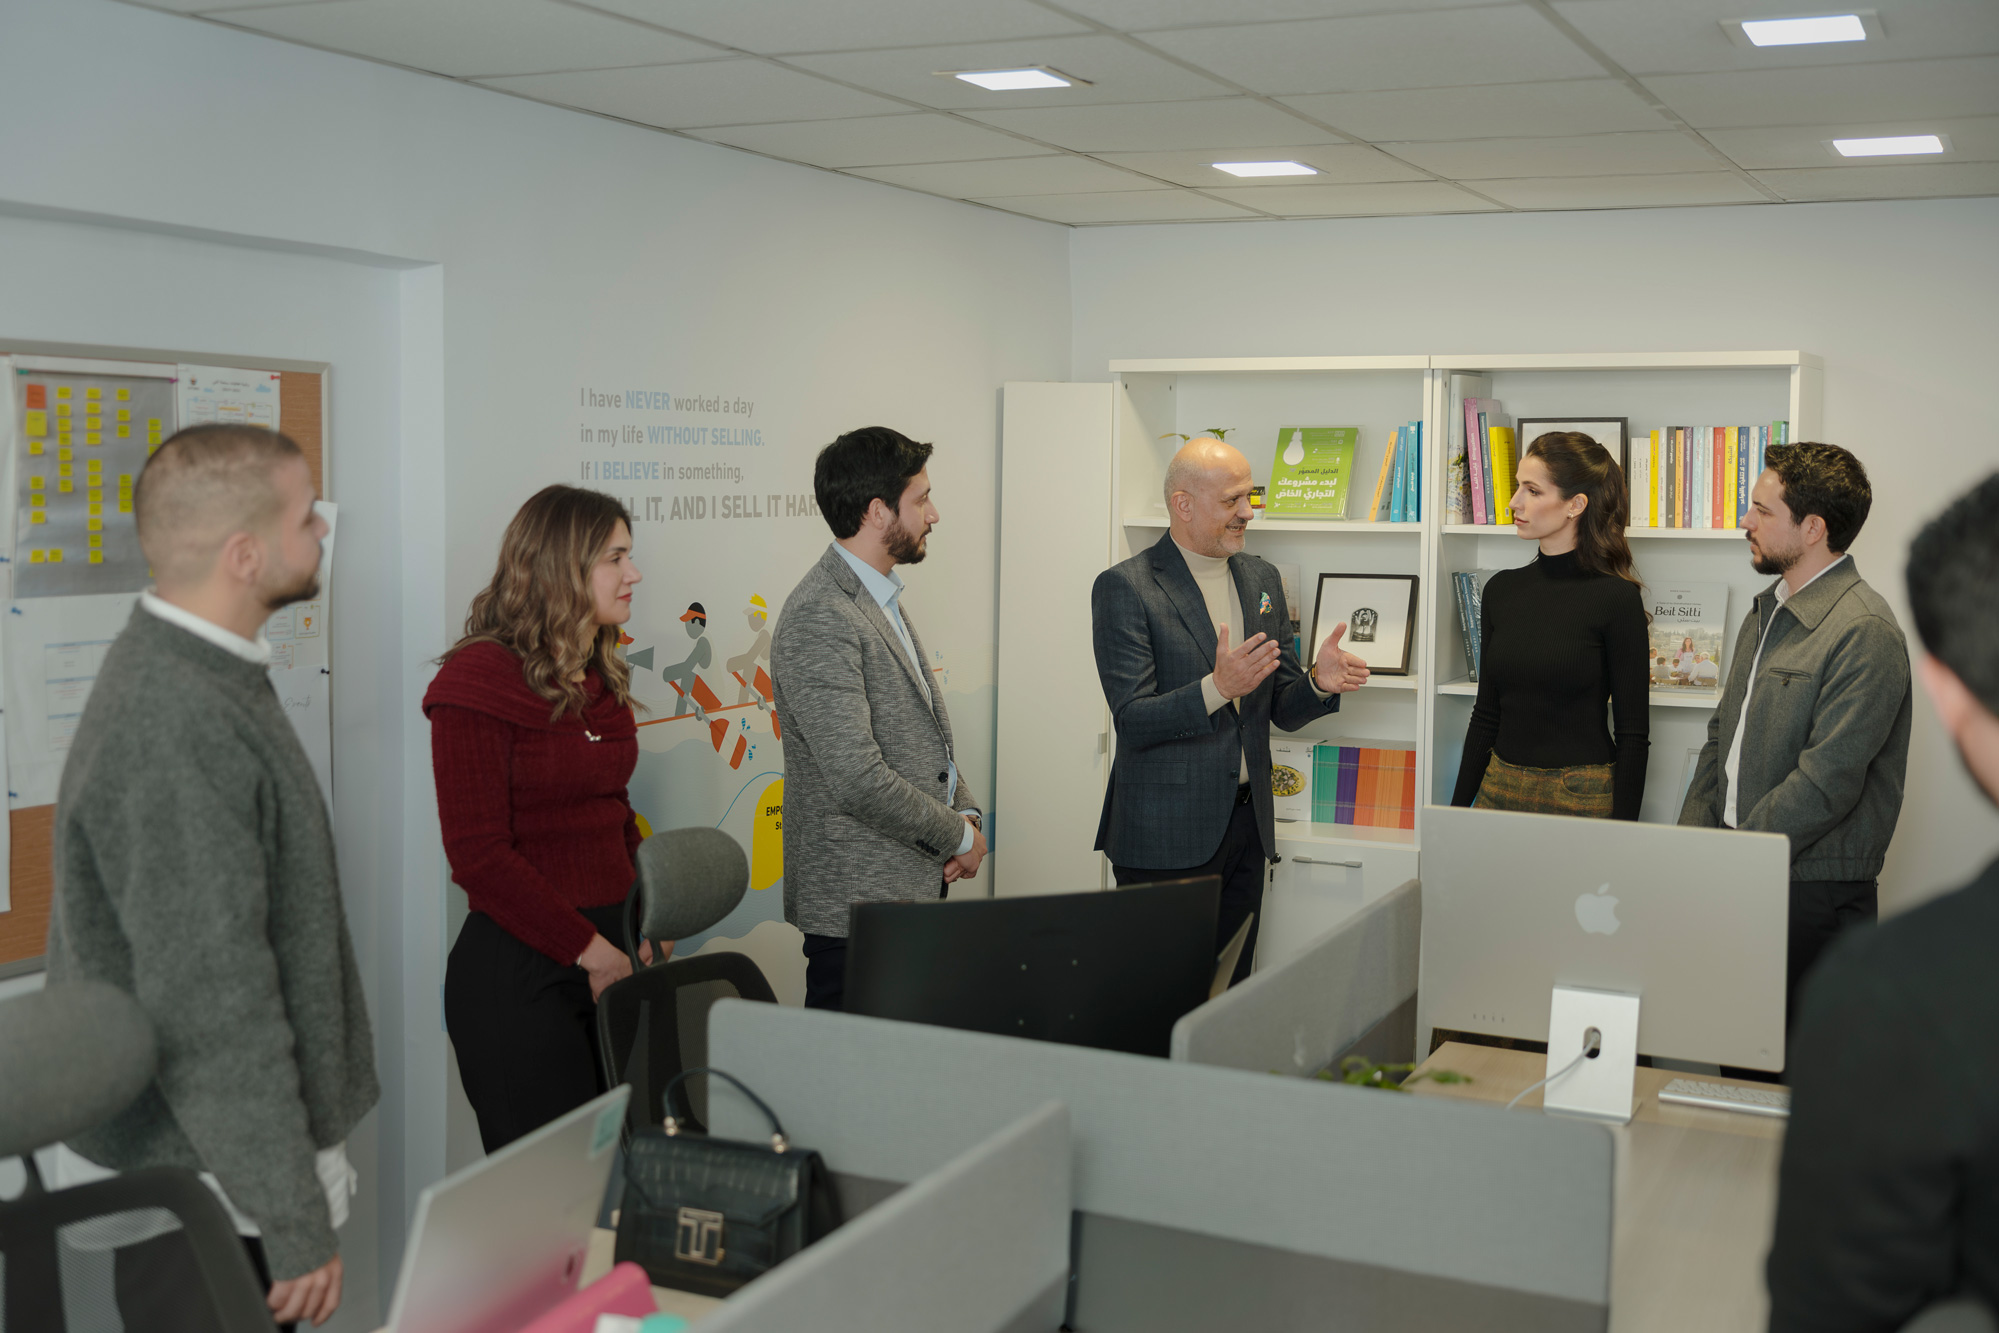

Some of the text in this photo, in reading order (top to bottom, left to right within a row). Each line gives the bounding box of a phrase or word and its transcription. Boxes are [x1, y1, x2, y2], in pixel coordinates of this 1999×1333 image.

[580, 387, 754, 418] I have NEVER worked a day
[580, 423, 765, 448] in my life WITHOUT SELLING.
[580, 460, 744, 484] If I BELIEVE in something,
[1277, 476, 1338, 488] لبدء مشروعك
[645, 496, 665, 524] IT,
[669, 495, 707, 521] AND
[711, 495, 717, 520] I
[721, 494, 763, 519] SELL
[767, 494, 782, 518] IT
[785, 494, 823, 517] HAR
[1654, 605, 1702, 617] Beit Sitti
